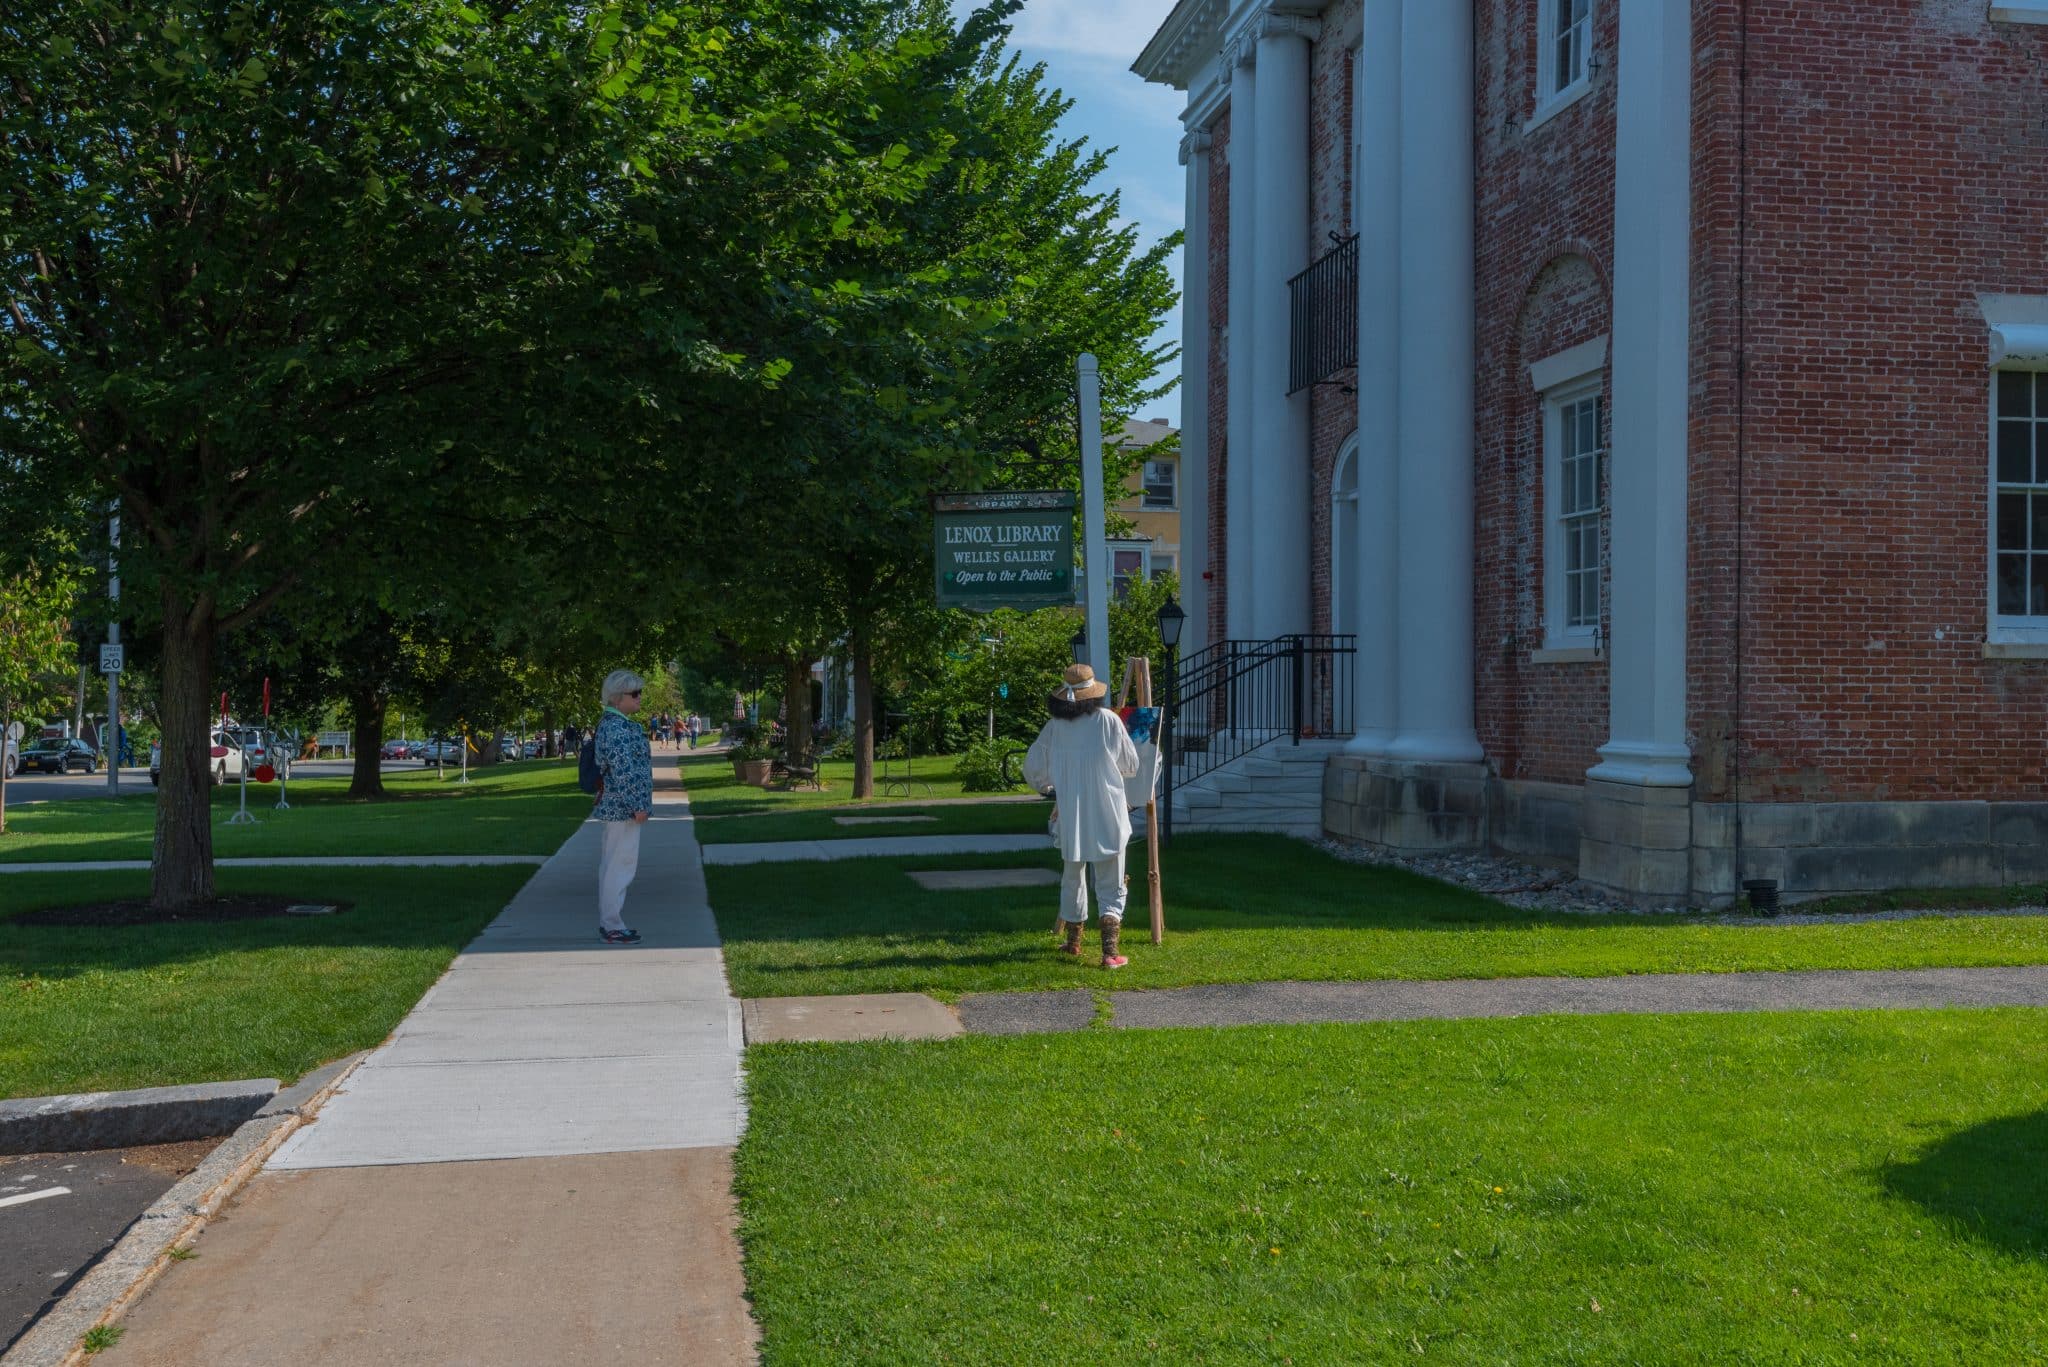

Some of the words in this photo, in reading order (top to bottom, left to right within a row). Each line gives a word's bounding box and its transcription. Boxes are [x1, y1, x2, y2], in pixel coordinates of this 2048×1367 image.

[945, 526, 993, 544] LENOX
[997, 525, 1063, 543] LIBRARY
[953, 551, 1000, 564] WELLES
[1004, 550, 1056, 562] GALLERY
[956, 570, 985, 585] Open
[986, 571, 996, 581] to
[999, 570, 1017, 581] the
[1019, 569, 1053, 581] Public
[103, 658, 120, 670] 20
